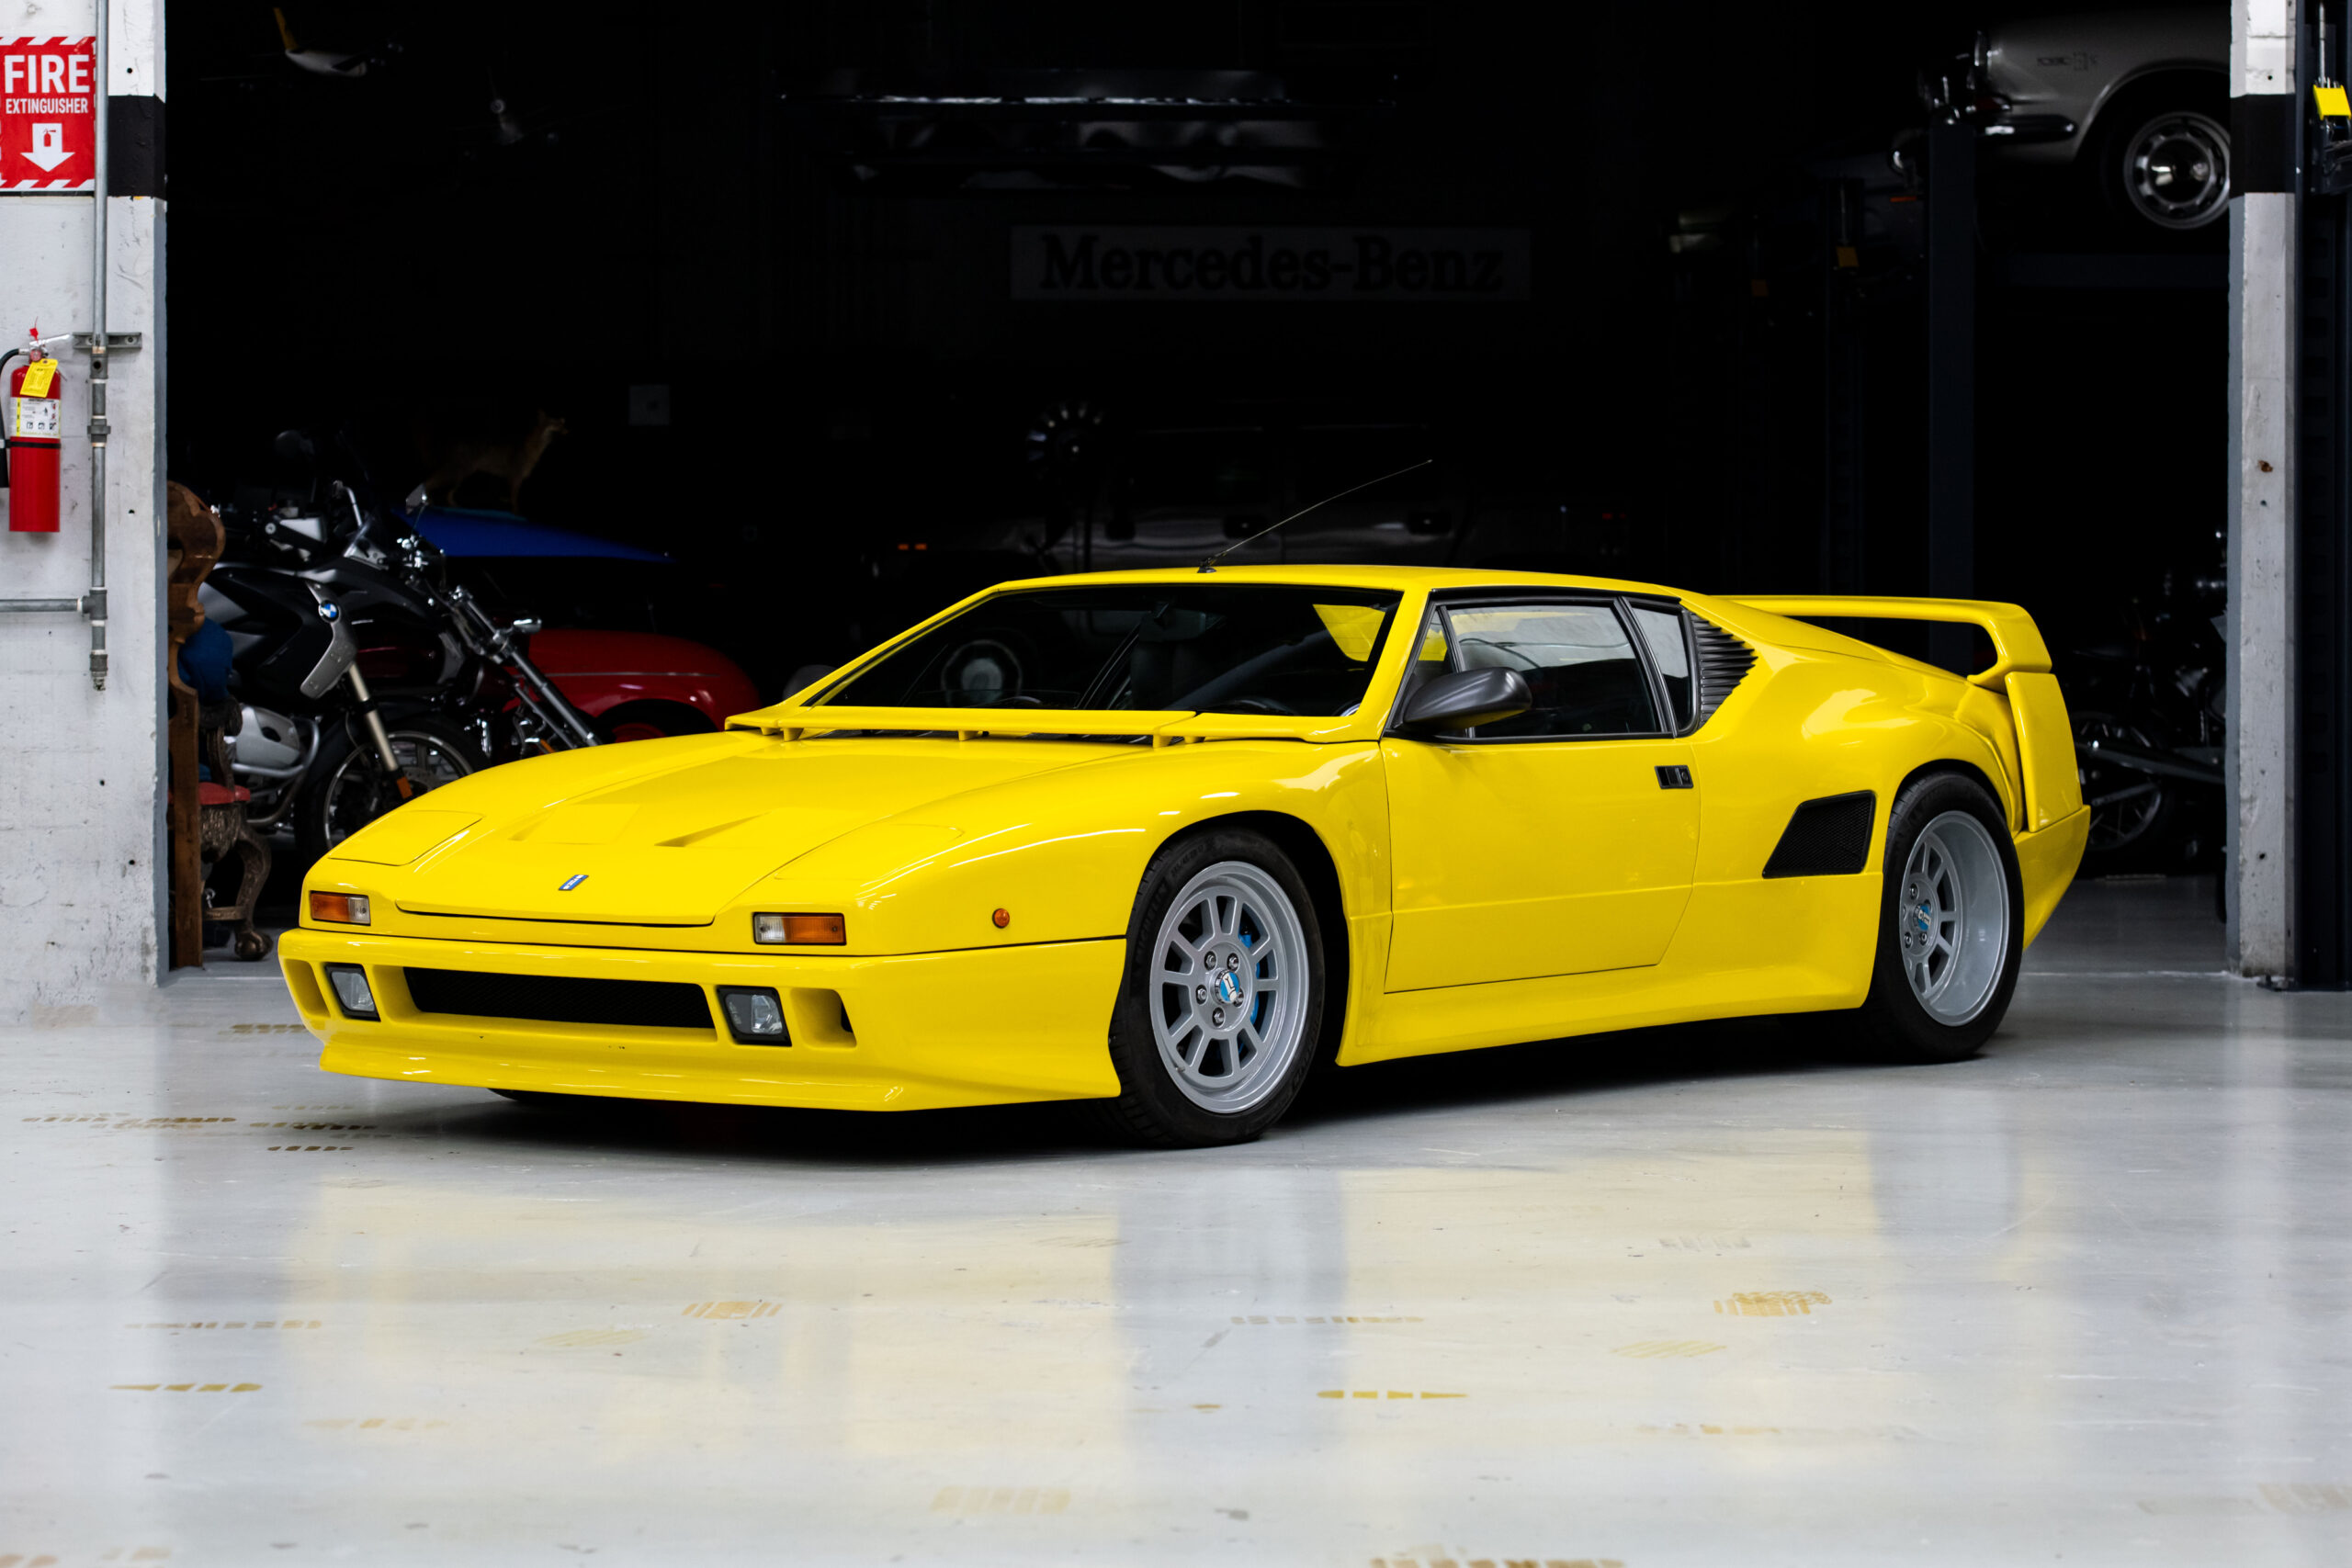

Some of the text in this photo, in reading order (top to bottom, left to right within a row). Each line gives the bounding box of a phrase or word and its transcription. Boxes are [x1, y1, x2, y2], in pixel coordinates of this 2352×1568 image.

[5, 55, 90, 94] FIRE
[6, 97, 88, 114] EXTINGUISHER
[1040, 234, 1505, 292] Mercedes-Benz
